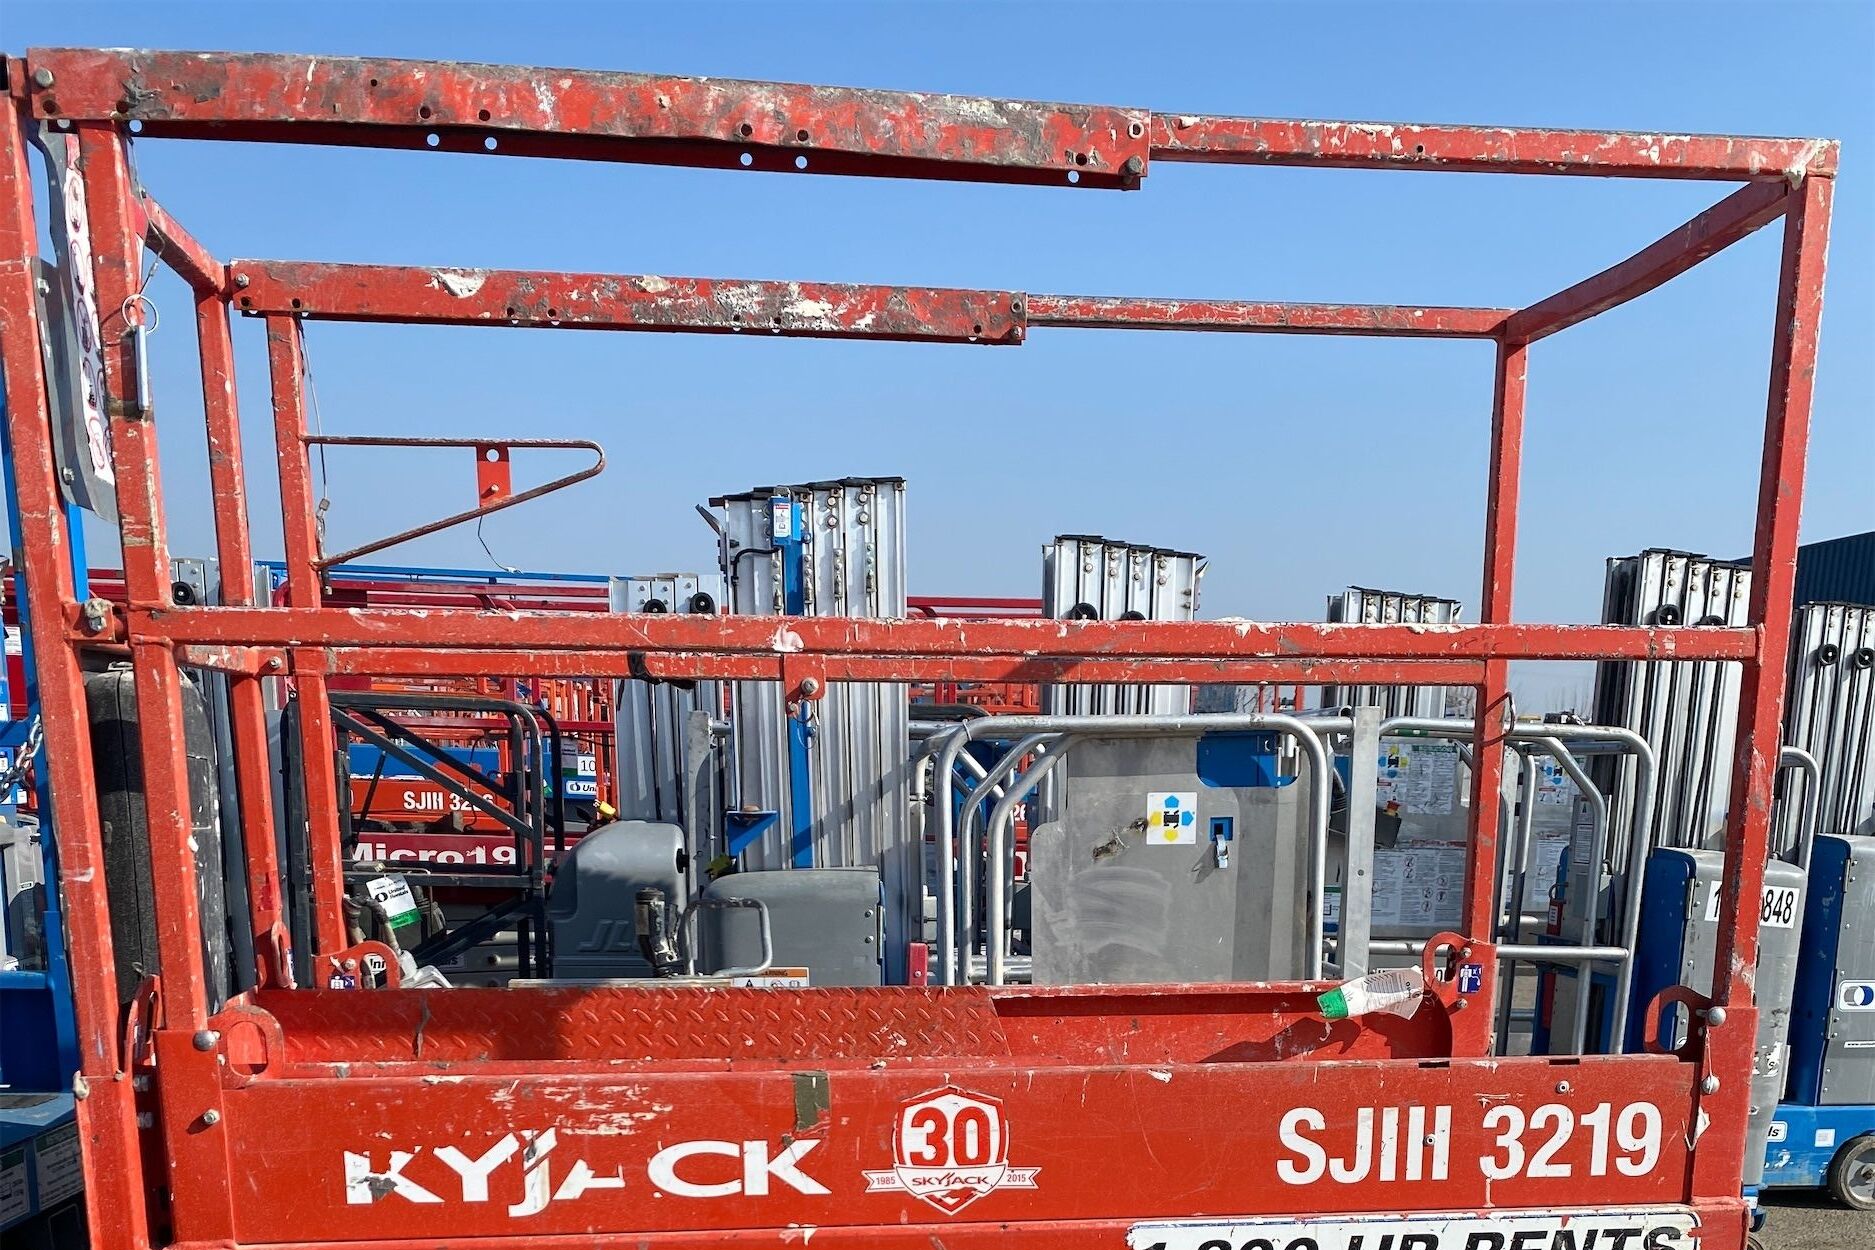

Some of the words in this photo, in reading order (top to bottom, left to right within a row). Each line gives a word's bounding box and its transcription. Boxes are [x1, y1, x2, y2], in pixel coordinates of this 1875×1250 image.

[1760, 889, 1794, 924] 848
[910, 1106, 990, 1166] 30
[1480, 1101, 1662, 1180] 3219
[876, 1175, 896, 1185] 1985
[912, 1172, 990, 1187] SKYJACK
[1007, 1173, 1026, 1183] 2015
